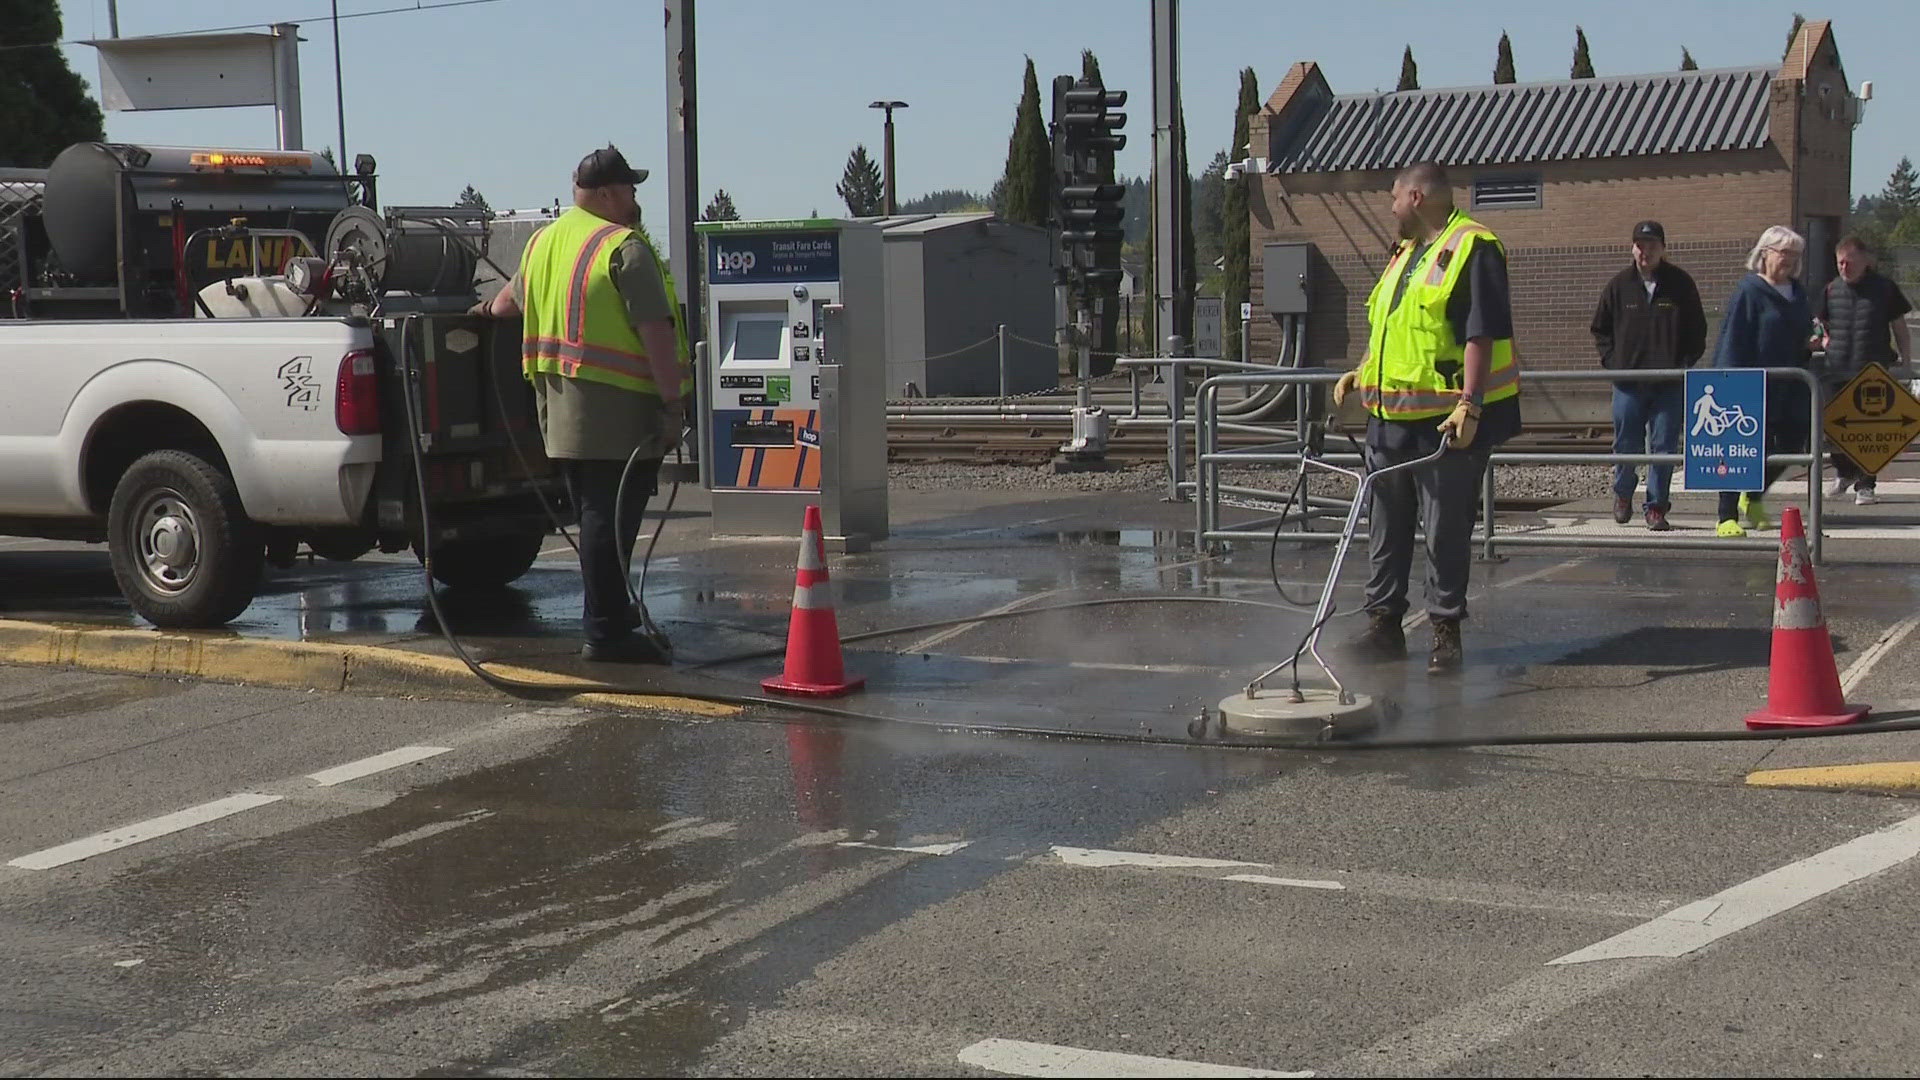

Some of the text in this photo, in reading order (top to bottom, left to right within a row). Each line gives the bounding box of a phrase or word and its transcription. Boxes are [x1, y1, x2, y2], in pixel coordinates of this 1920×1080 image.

[772, 240, 832, 252] Transit Fare Cards
[717, 245, 756, 275] hop
[803, 431, 818, 442] hop
[1841, 432, 1907, 442] LOOK BOTH
[1691, 443, 1758, 458] Walk Bike
[1858, 444, 1889, 454] WAYS
